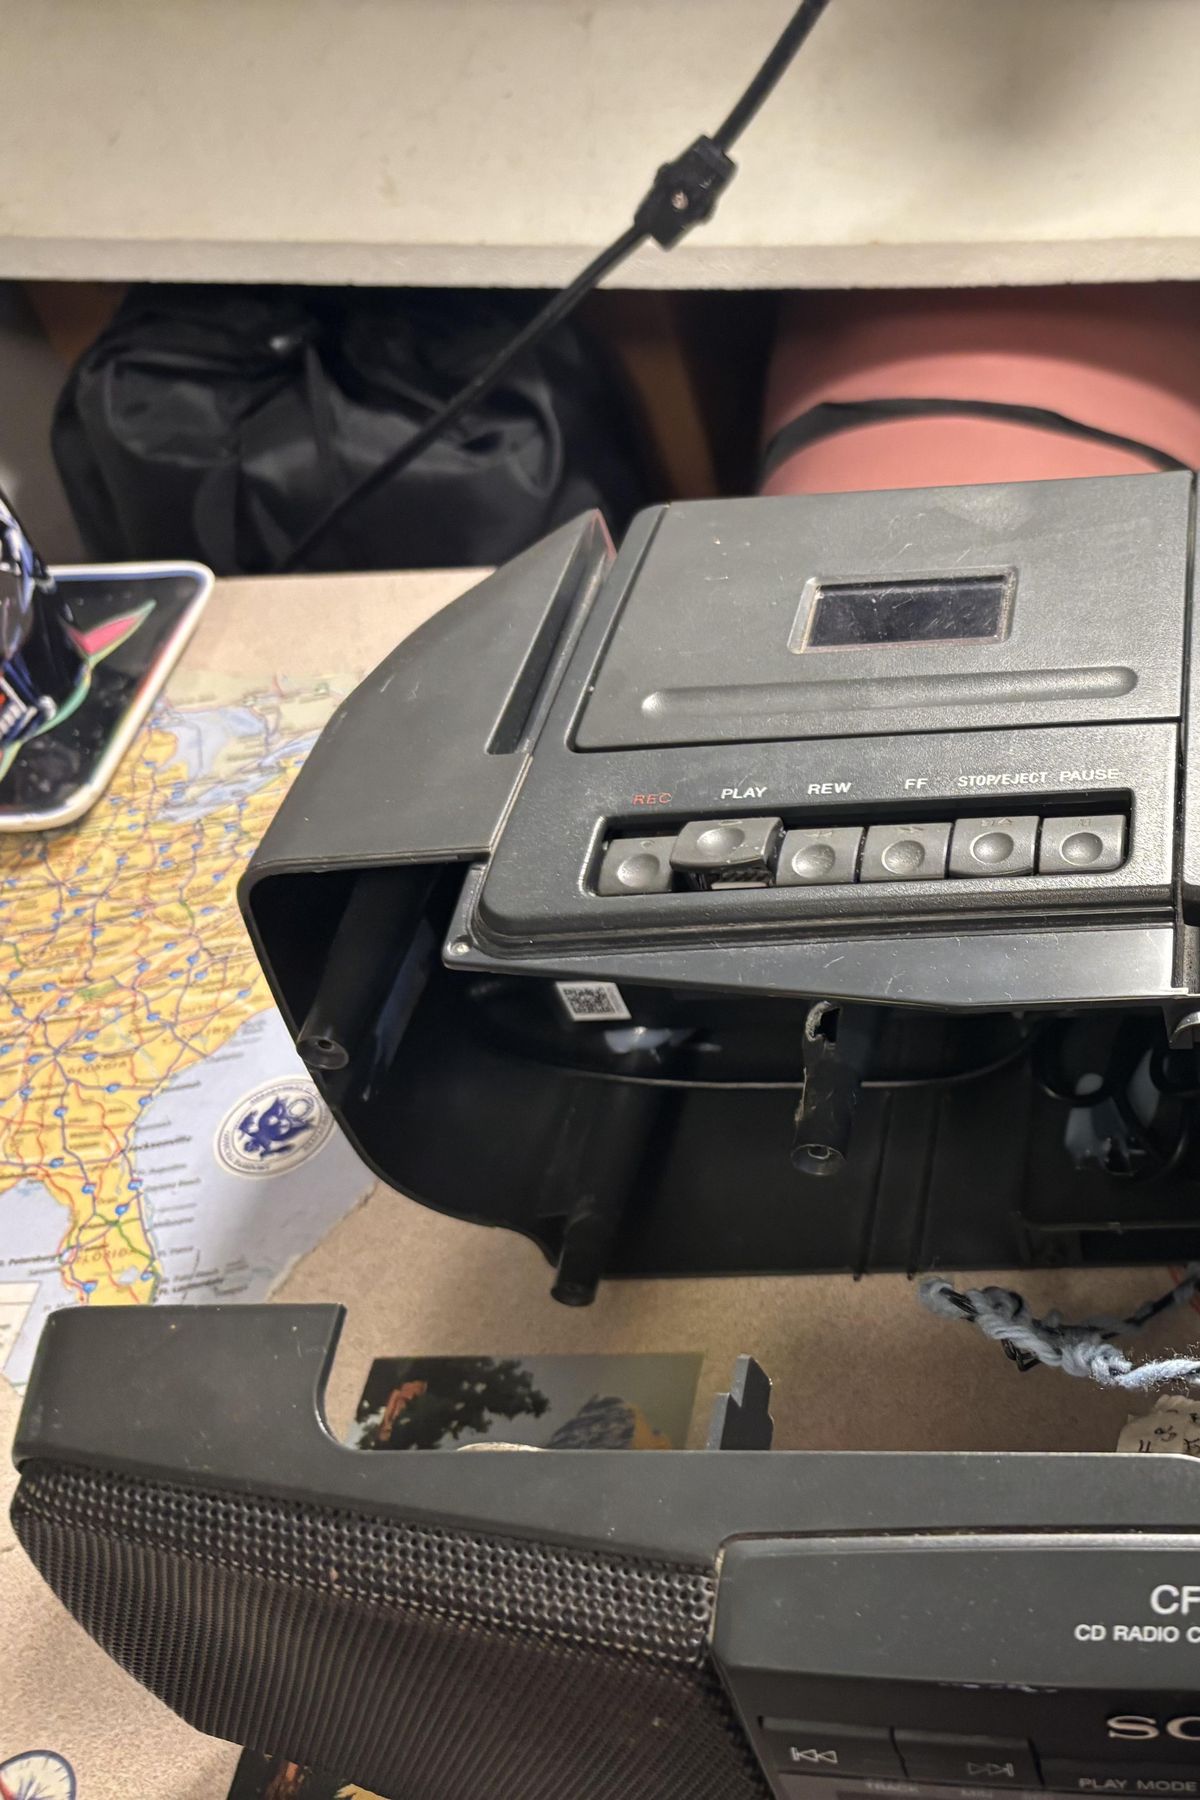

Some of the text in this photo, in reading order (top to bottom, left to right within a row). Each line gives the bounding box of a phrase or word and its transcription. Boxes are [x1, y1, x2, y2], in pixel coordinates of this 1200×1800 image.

[632, 769, 1120, 806] REC PLAY REW FF STOP/EJECT PAUSE
[1074, 1624, 1106, 1641] CD
[1113, 1625, 1180, 1643] RADIO
[1079, 1777, 1198, 1792] PLAY MODE
